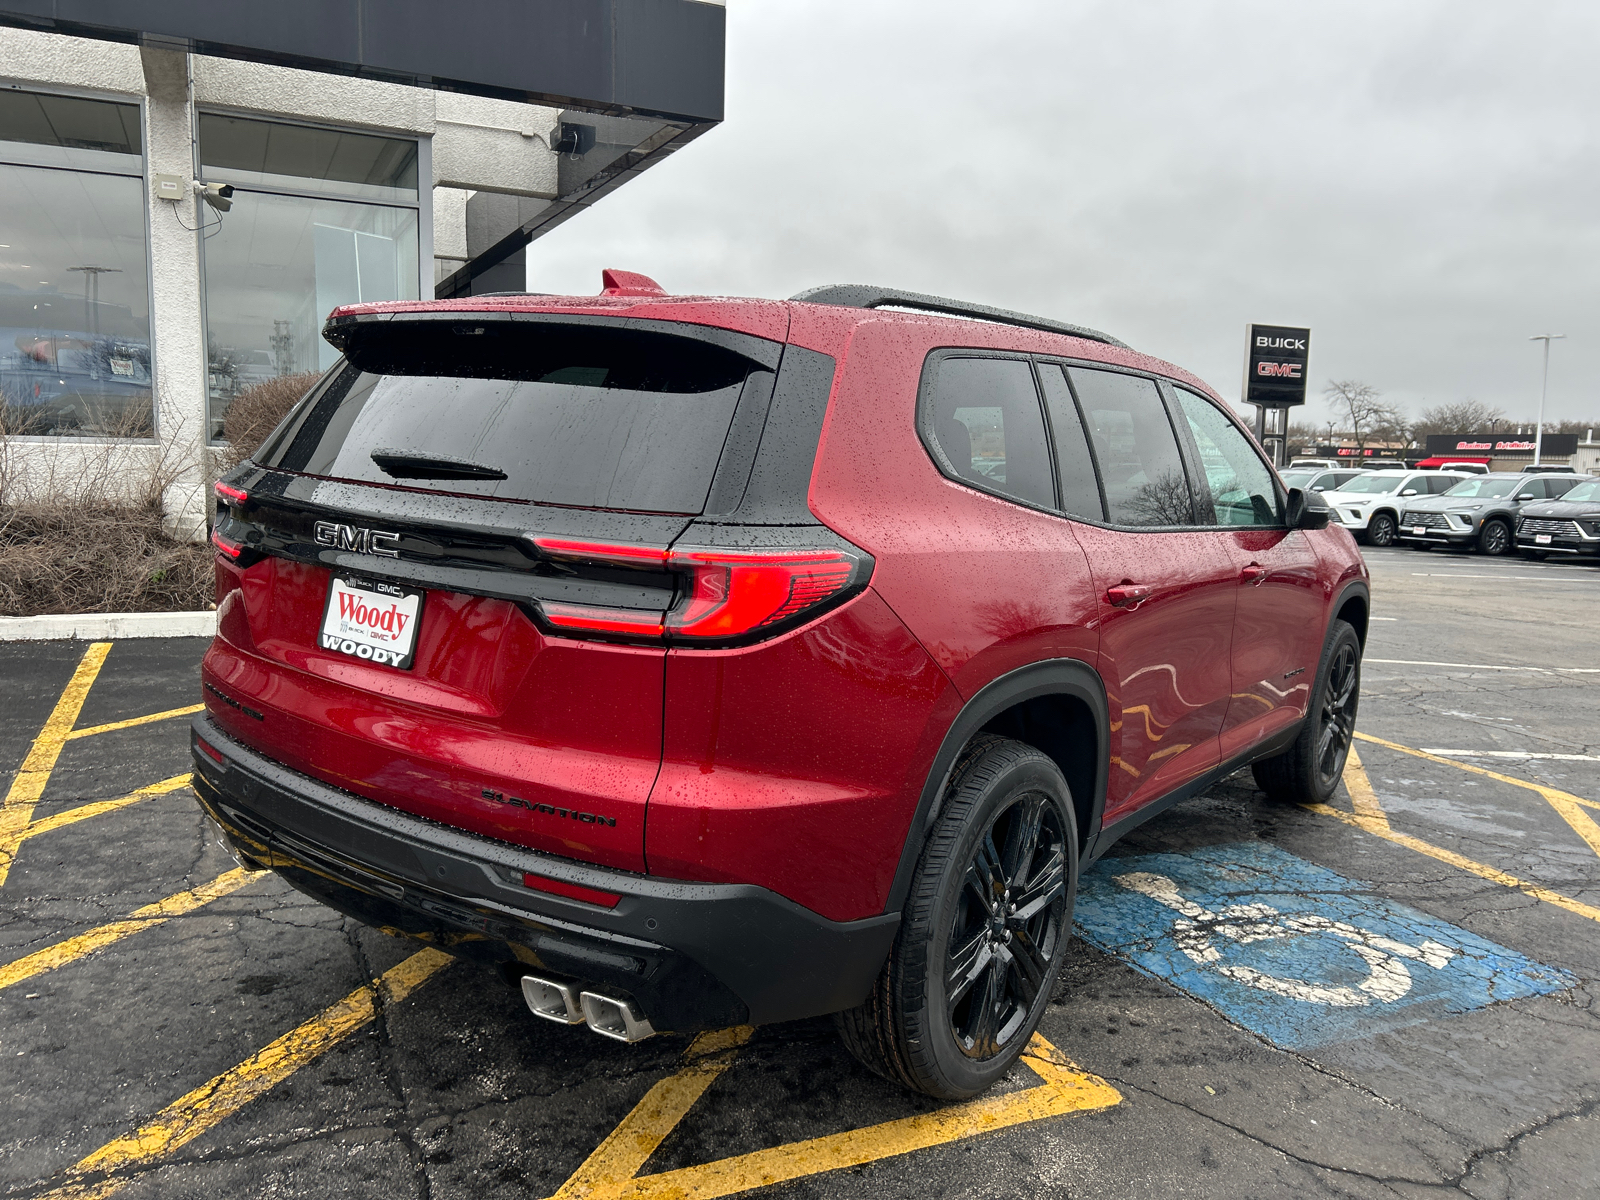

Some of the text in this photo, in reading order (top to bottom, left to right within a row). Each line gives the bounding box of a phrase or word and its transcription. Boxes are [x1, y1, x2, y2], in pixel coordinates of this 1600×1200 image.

[1256, 336, 1305, 350] BUICK
[1257, 361, 1302, 378] GMC
[1456, 441, 1492, 450] Maximum
[313, 520, 400, 559] GMC
[377, 583, 401, 595] GMC
[338, 591, 410, 641] Woody
[370, 631, 389, 642] GMC
[322, 634, 406, 667] WOODY
[481, 788, 617, 828] ELEVATION
